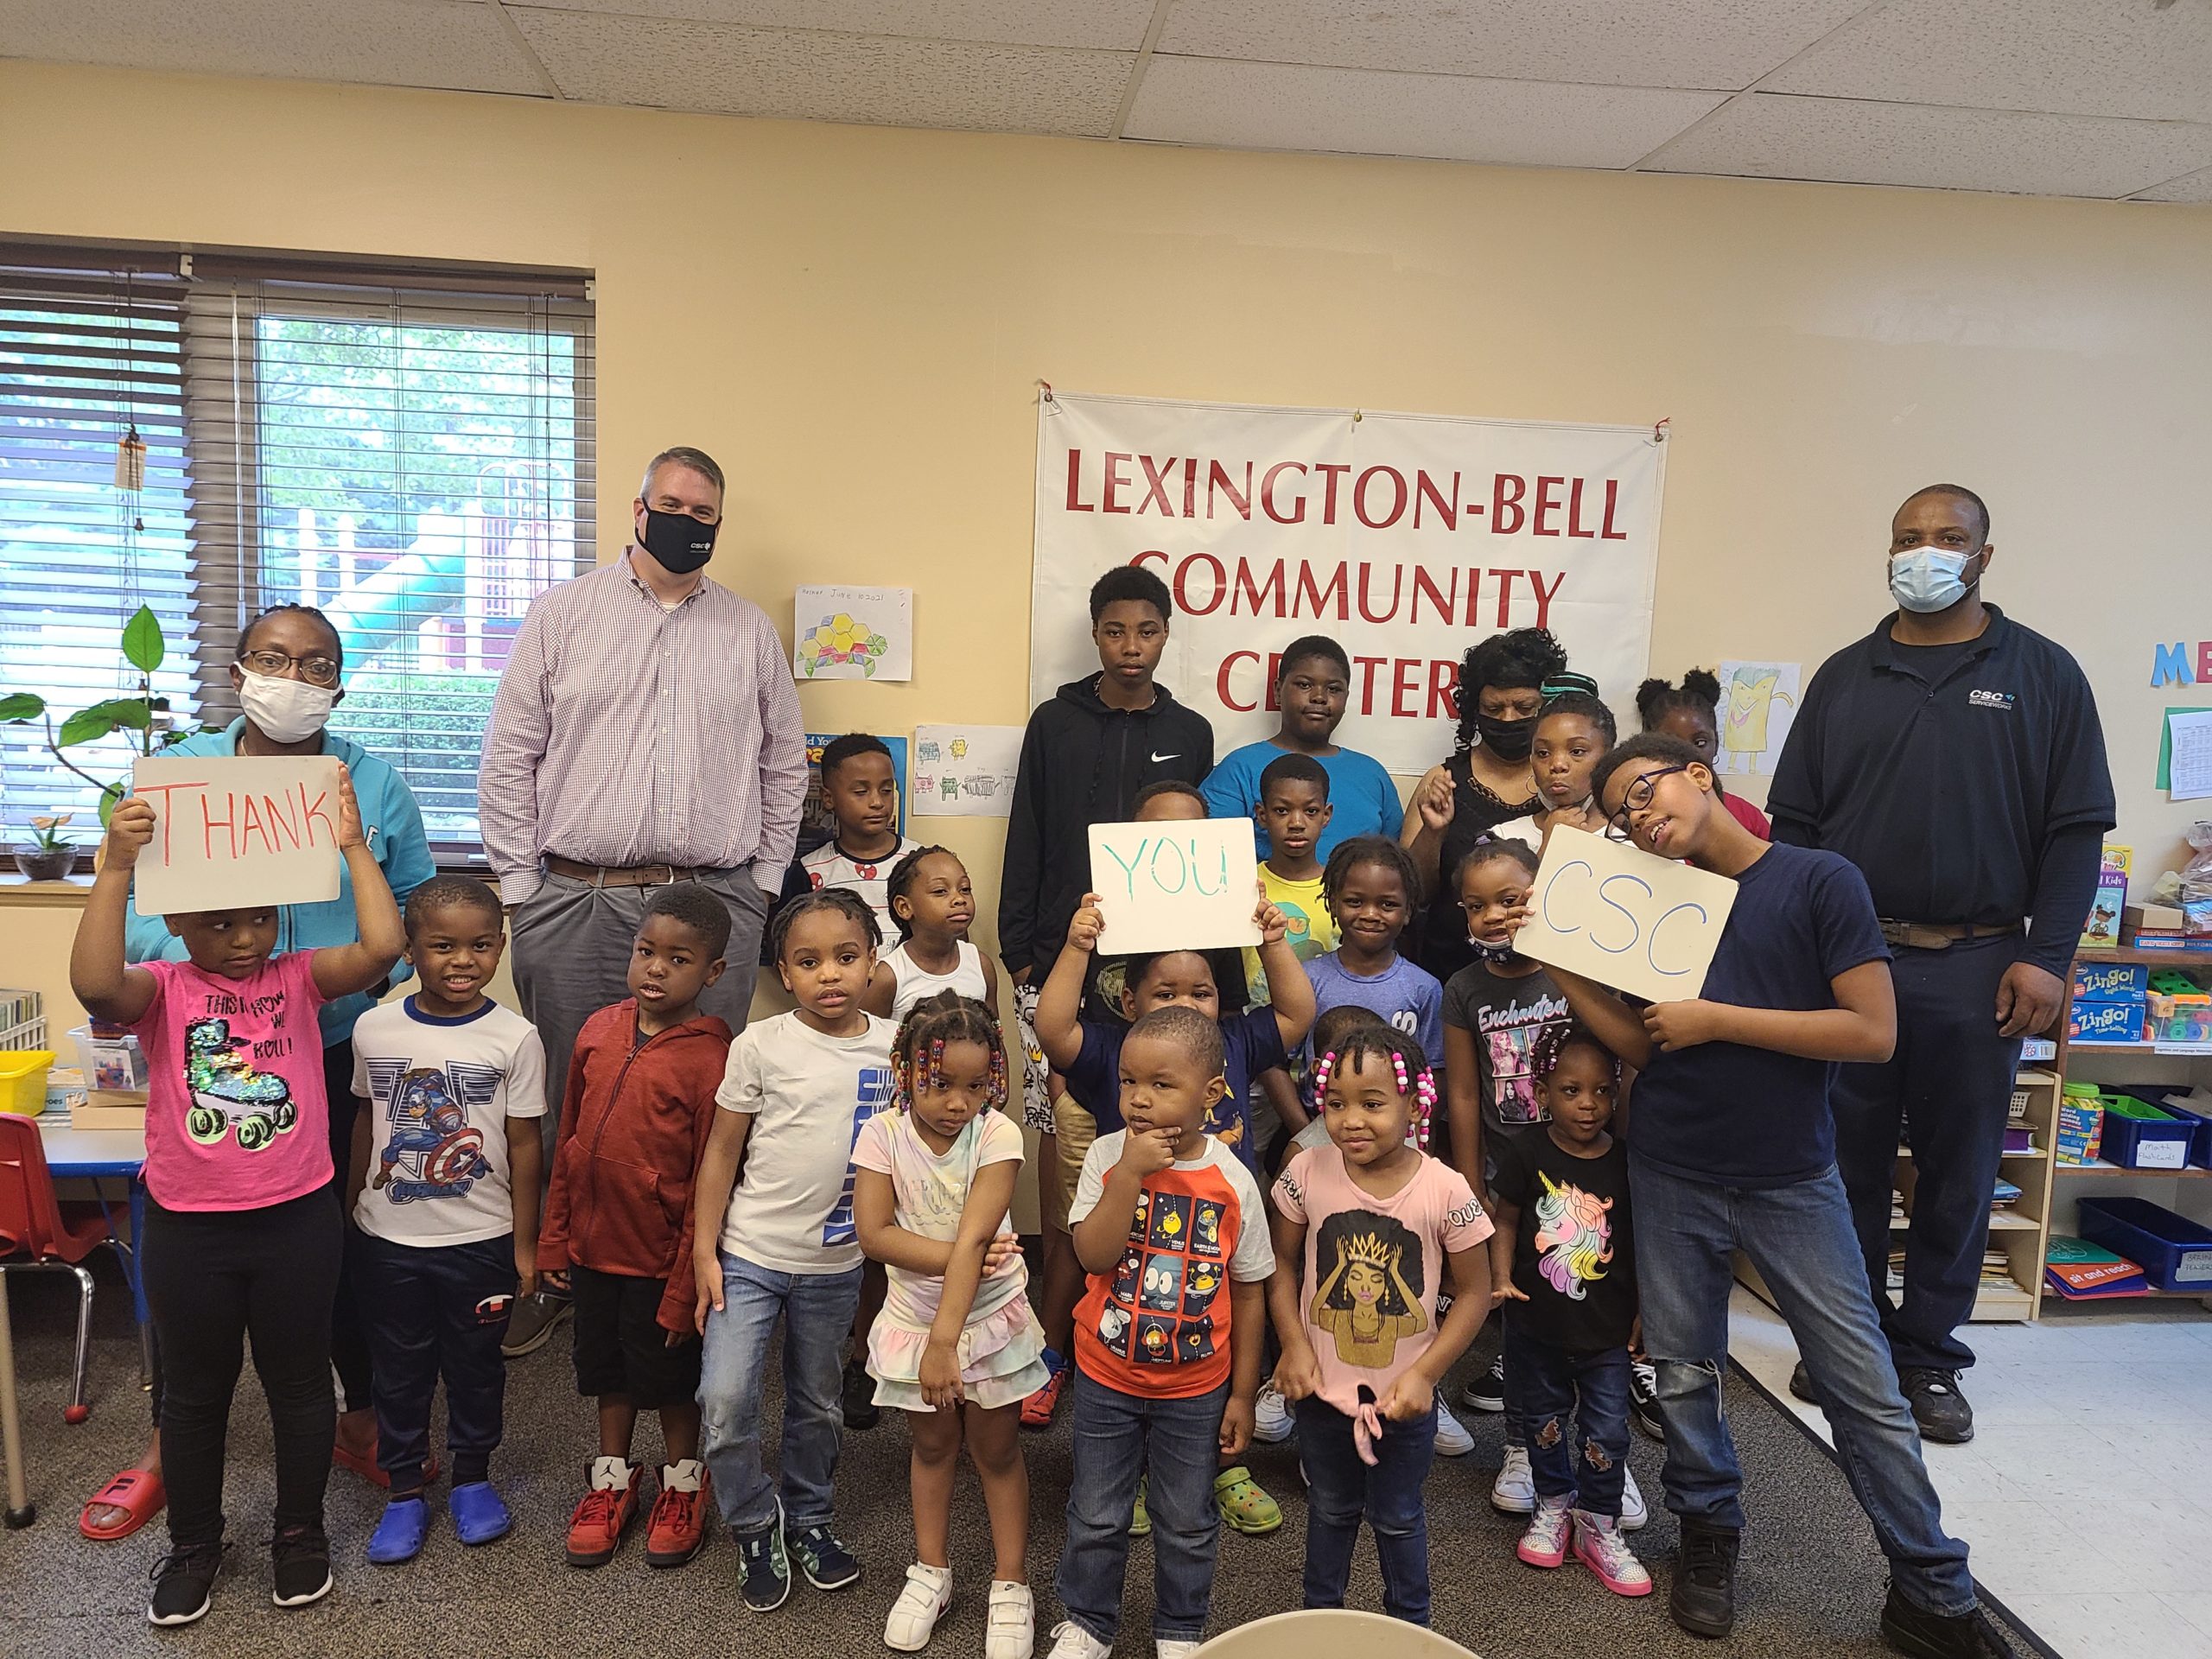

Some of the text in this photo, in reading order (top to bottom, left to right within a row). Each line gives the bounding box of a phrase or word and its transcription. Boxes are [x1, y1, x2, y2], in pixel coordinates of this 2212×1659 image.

[1065, 448, 1627, 541] LEXINGTON-BELL
[1216, 650, 1461, 719] CTER
[1969, 690, 2004, 701] CSC
[133, 781, 339, 867] THANK
[1102, 836, 1227, 902] YOU
[2105, 874, 2123, 886] Kids
[1543, 860, 1707, 976] CSC
[2082, 968, 2135, 993] Zingo!
[205, 995, 238, 1014] THIS
[1478, 993, 1569, 1033] Enchanted
[2077, 1007, 2130, 1032] Zingo!
[1447, 1198, 1484, 1227] QUE
[2069, 1263, 2134, 1283] sit and reach
